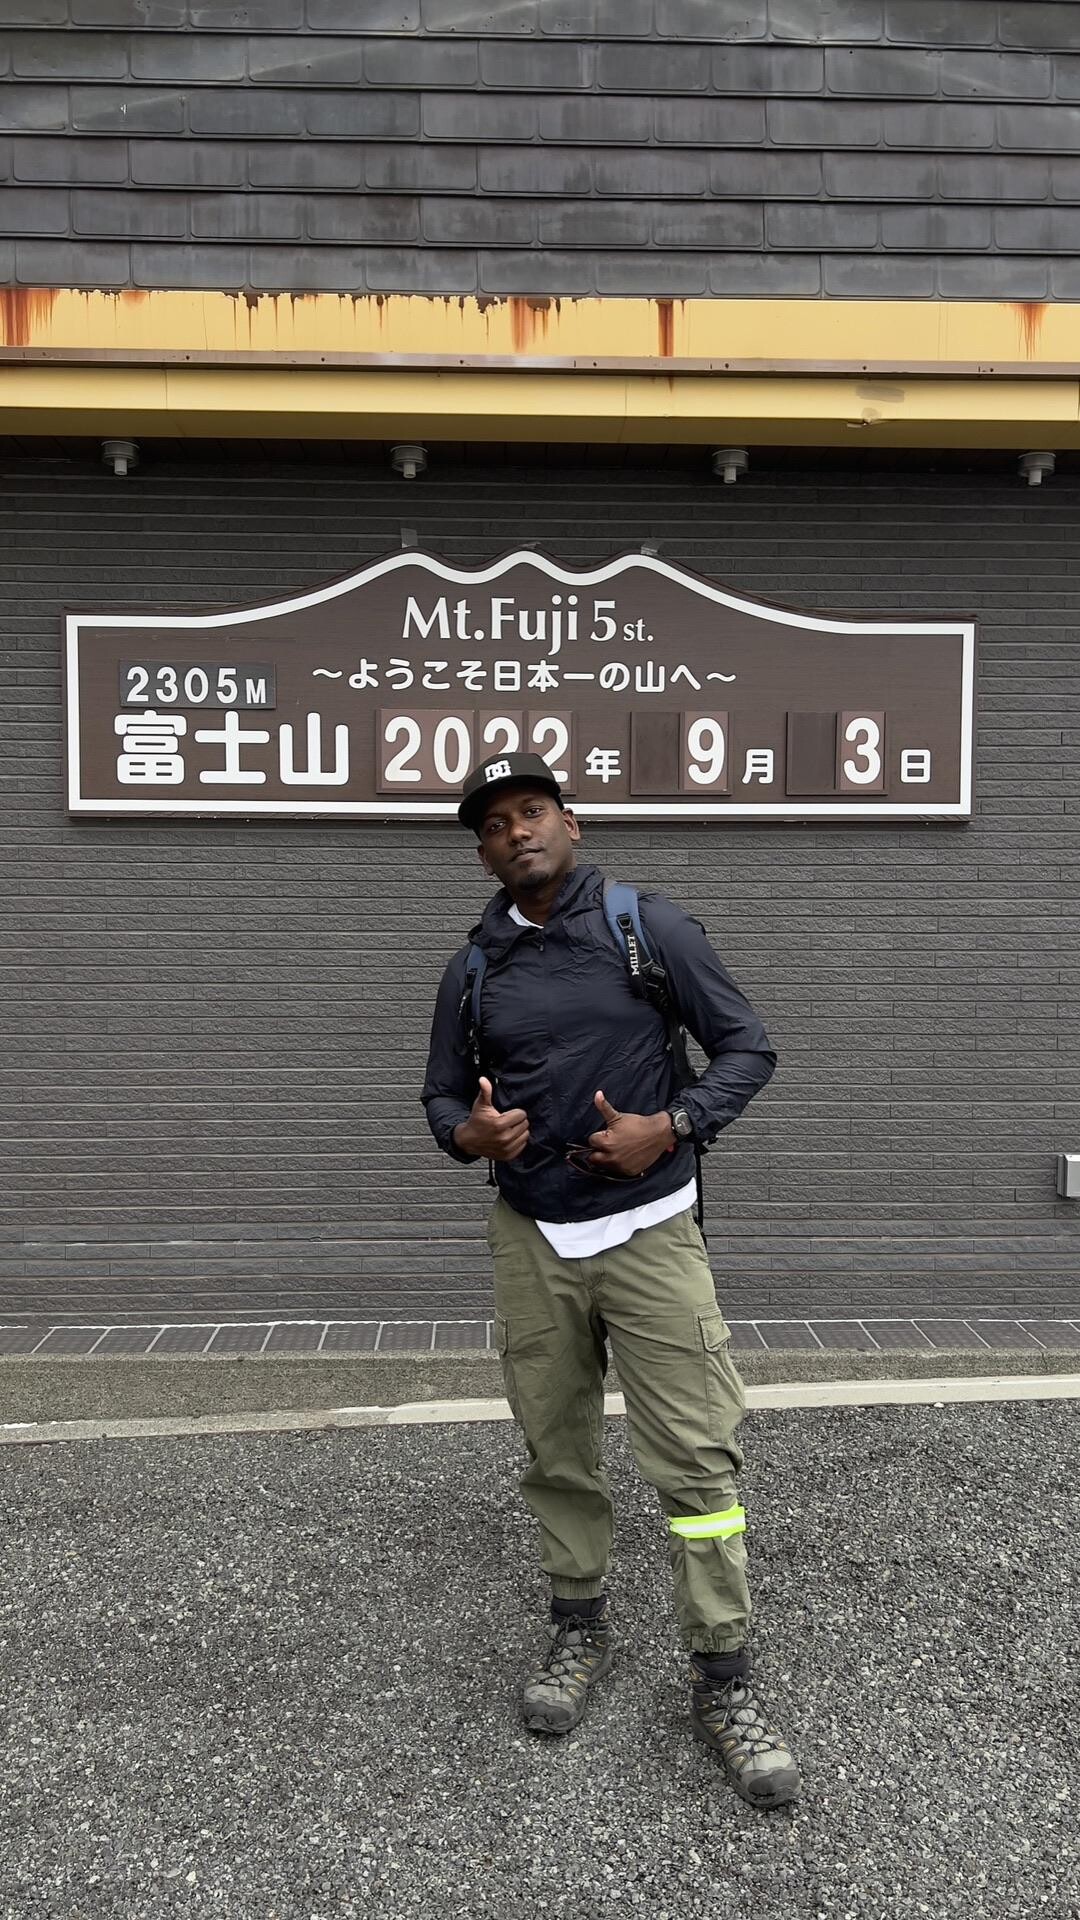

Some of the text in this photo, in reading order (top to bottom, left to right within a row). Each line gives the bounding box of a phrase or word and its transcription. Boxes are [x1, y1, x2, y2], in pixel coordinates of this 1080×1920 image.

[402, 594, 578, 656] Mt.Fuji
[114, 709, 349, 786] 富士山
[627, 935, 640, 976] MILLET
